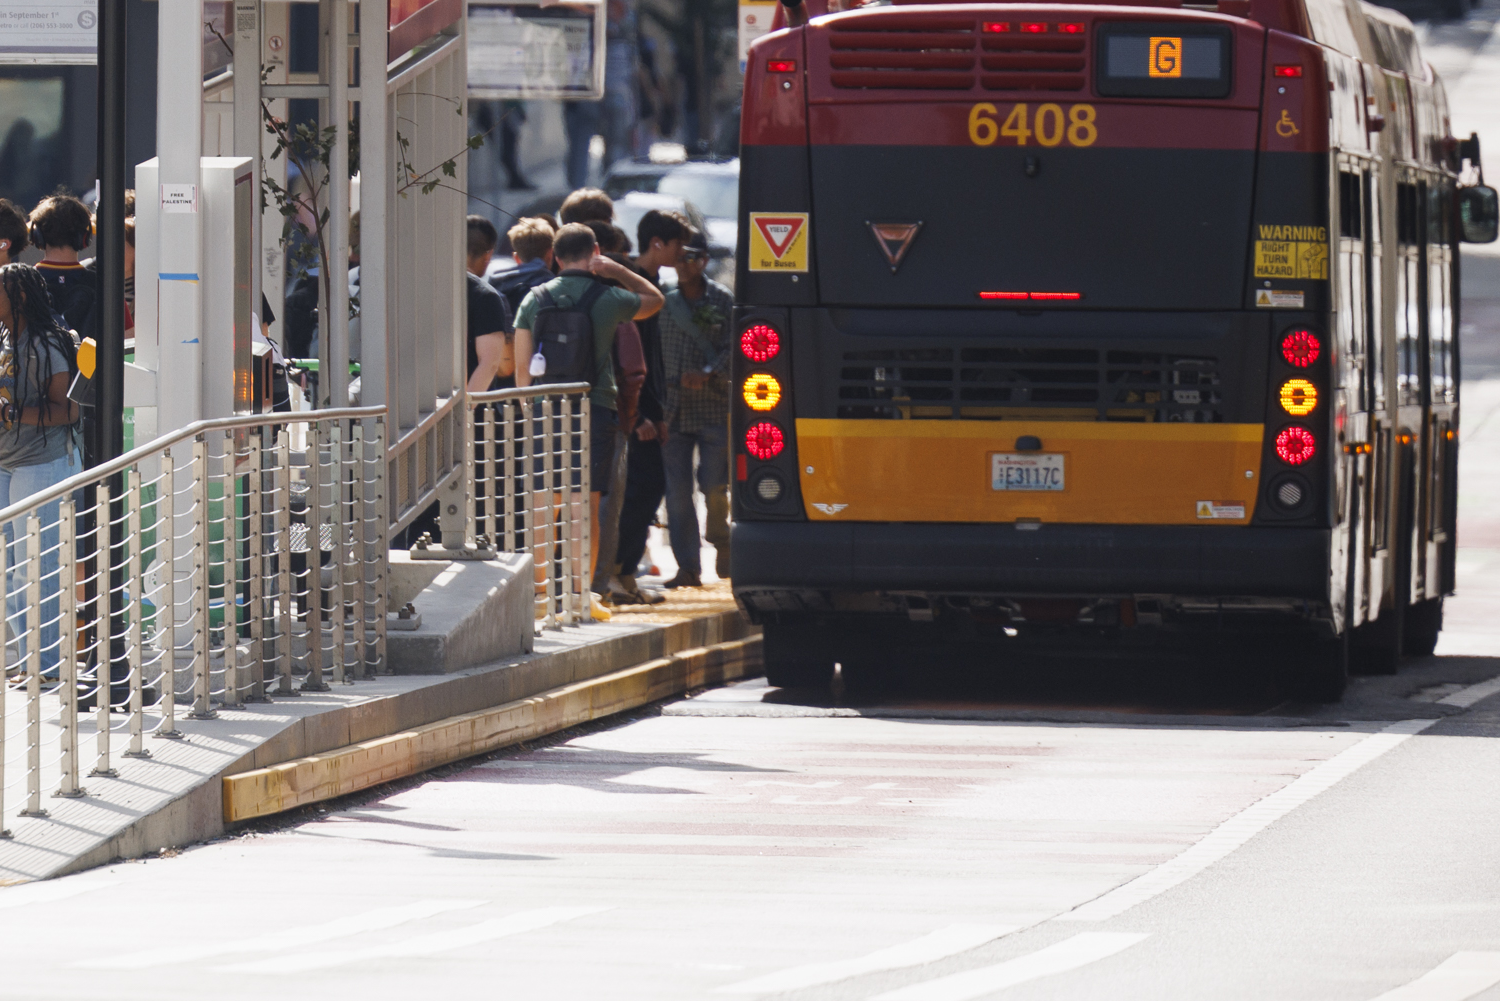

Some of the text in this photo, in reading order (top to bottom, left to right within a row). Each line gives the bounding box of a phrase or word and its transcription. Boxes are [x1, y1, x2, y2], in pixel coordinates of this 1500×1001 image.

[9, 12, 49, 20] September
[1155, 40, 1177, 74] G
[968, 102, 1098, 147] 6408
[1259, 225, 1326, 241] WARNING
[1261, 243, 1290, 253] RIGHT
[761, 259, 796, 267] for Buses
[1263, 254, 1288, 264] TURN
[1257, 265, 1293, 276] HAZARD
[1006, 466, 1060, 485] E3117C
